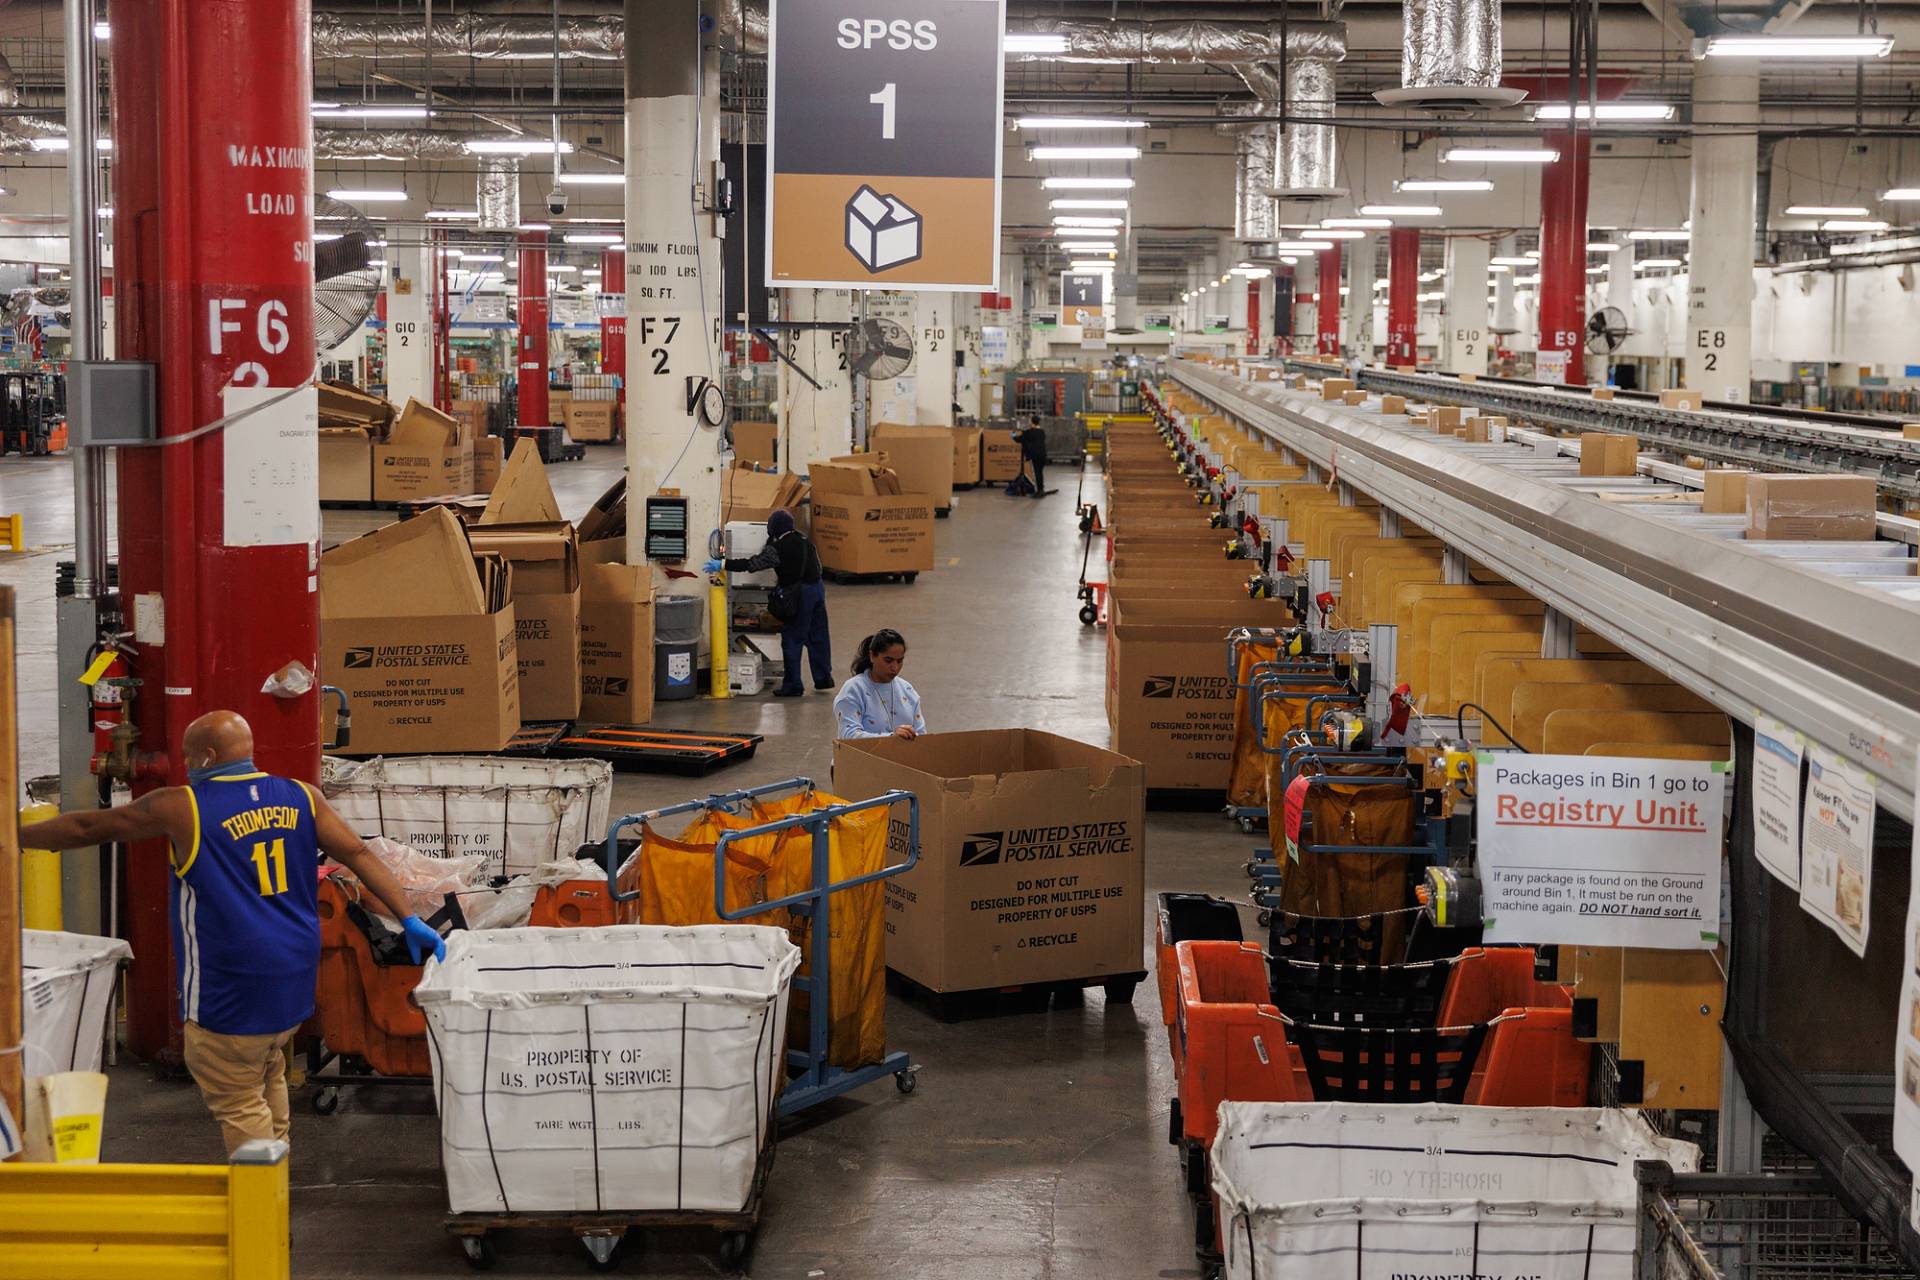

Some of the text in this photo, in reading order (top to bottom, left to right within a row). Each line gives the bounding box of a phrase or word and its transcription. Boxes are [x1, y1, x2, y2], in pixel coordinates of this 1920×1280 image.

[836, 18, 938, 51] SPSS
[869, 83, 896, 139] 1
[247, 193, 295, 215] LOAD
[667, 244, 699, 255] FLOOR
[650, 265, 667, 276] 100
[1079, 288, 1086, 301] 1
[208, 299, 290, 355] F6
[395, 322, 416, 333] G10
[641, 317, 681, 345] F7
[924, 328, 945, 340] F10
[401, 336, 409, 347] 2
[1456, 329, 1480, 342] E10
[1554, 331, 1577, 347] E9
[1697, 330, 1726, 348] E8
[930, 341, 938, 352] 2
[1465, 344, 1473, 355] 2
[651, 348, 670, 375] 2
[838, 352, 848, 371] 2
[1704, 353, 1717, 371] 2
[377, 644, 465, 656] UNITED STATES
[375, 655, 419, 668] POSTAL
[385, 678, 431, 687] DO NOT CUT
[1180, 676, 1228, 688] UNITED
[353, 687, 465, 698] DESIGNED FOR MULTIPLE USE
[1176, 688, 1223, 700] POSTAL
[373, 698, 446, 708] PROPERTY OF USPS
[396, 716, 433, 725] RECYCLE
[1186, 712, 1198, 720] DO
[1200, 712, 1217, 720] NOT
[1150, 722, 1192, 730] DESIGNED
[1194, 722, 1210, 730] FOR
[1171, 733, 1214, 741] PROPERTY
[1215, 733, 1226, 741] OF
[1496, 768, 1709, 794] Packages in Bin 1 go to
[1497, 794, 1705, 826] Registry Unit.
[222, 806, 299, 840] THOMPSON
[475, 833, 490, 845] OF
[1007, 821, 1127, 845] UNITED STATES
[1005, 844, 1065, 863] POSTAL
[251, 838, 289, 896] 11
[1016, 876, 1079, 891] DO NOT CUT
[1493, 872, 1703, 890] If any package is found on the Ground
[906, 891, 917, 903] USE
[970, 886, 1123, 912] DESIGNED FOR MULTIPLE USE
[1502, 886, 1541, 898] around
[1544, 887, 1563, 899] Bin
[1579, 889, 1587, 900] It
[1589, 890, 1616, 901] must
[1619, 890, 1634, 902] be
[1637, 894, 1655, 902] run
[1658, 895, 1672, 903] on
[1675, 893, 1693, 904] the
[892, 898, 904, 912] USPS
[1492, 900, 1702, 918] machine again. DO NOT hand sort it.
[998, 904, 1097, 924] PROPERTY OF USPS
[1029, 933, 1077, 948] RECYCLE
[616, 962, 630, 970] 3/4
[527, 1049, 642, 1066] PROPERTY OF
[501, 1069, 672, 1088] U.S. POSTAL SERVICE
[535, 1121, 563, 1129] TARE
[1425, 1145, 1443, 1157] 3/4
